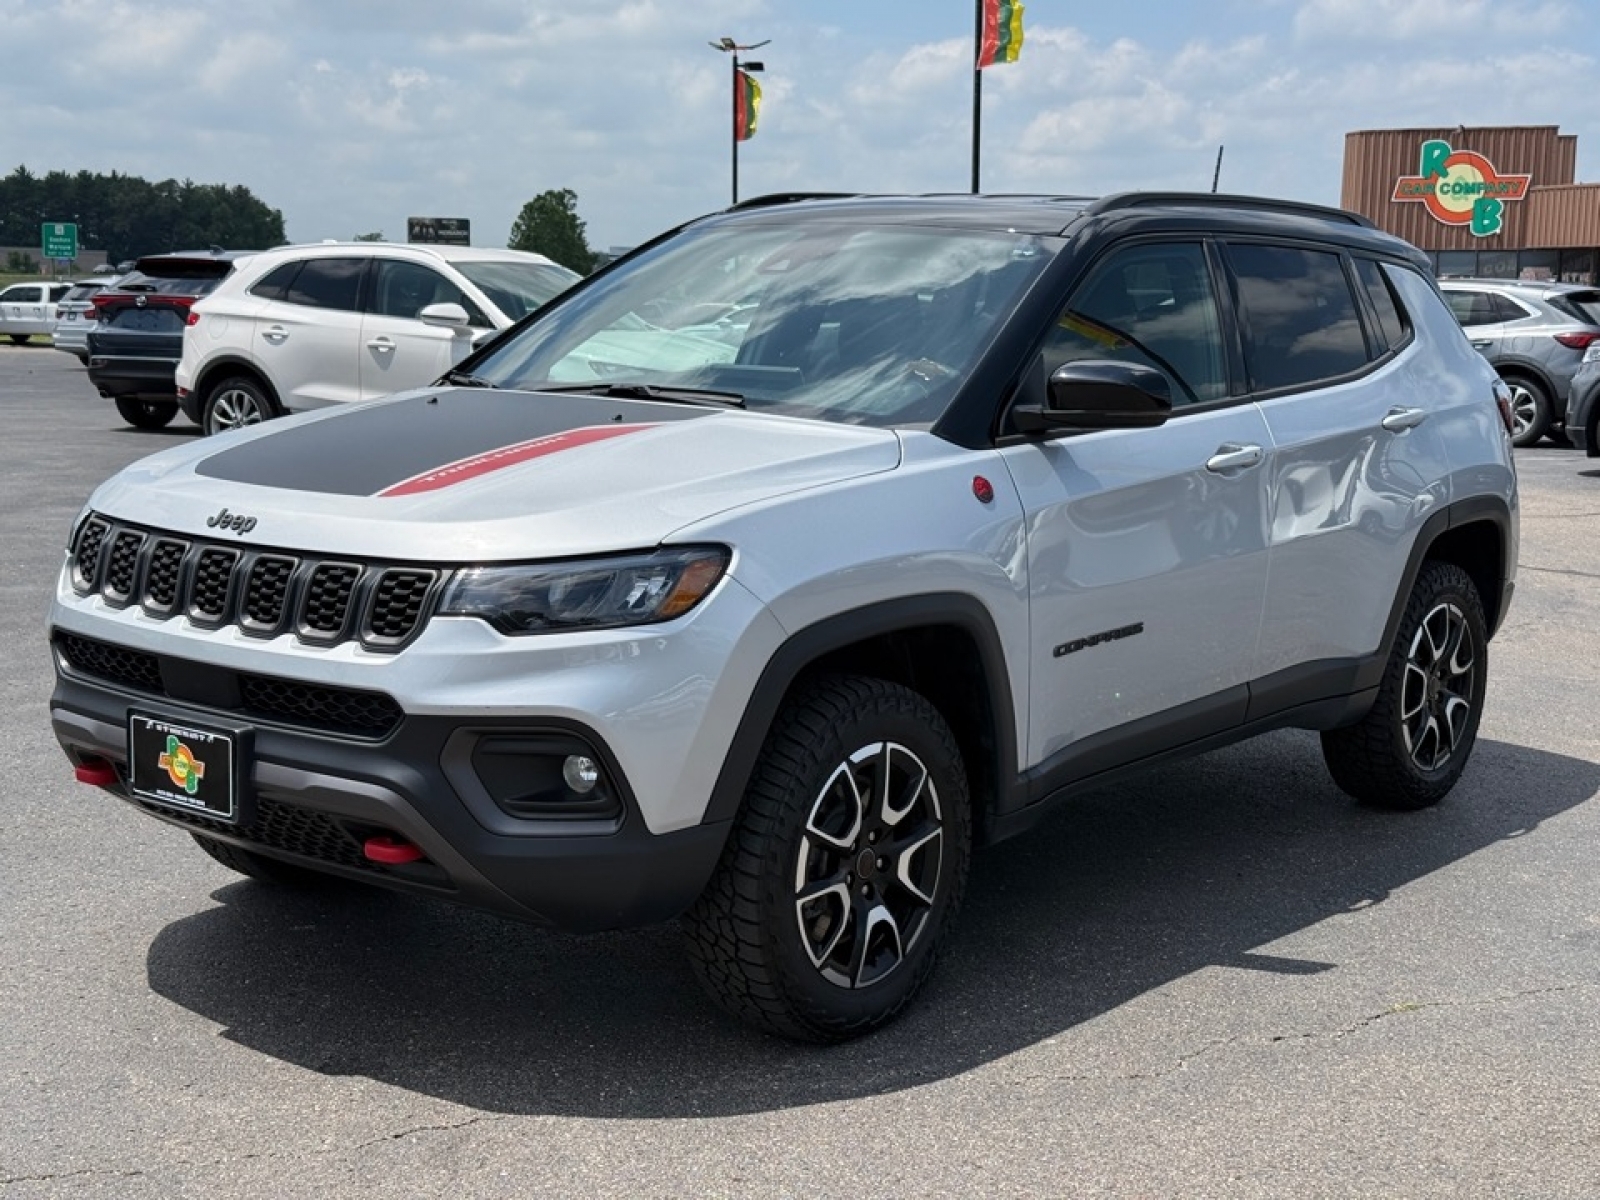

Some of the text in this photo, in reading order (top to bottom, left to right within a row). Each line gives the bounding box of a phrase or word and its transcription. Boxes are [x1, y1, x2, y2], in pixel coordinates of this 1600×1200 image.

[1422, 140, 1451, 178] R
[1402, 182, 1521, 195] CAR COMPANY
[1472, 198, 1502, 235] B
[207, 508, 258, 536] Jeep
